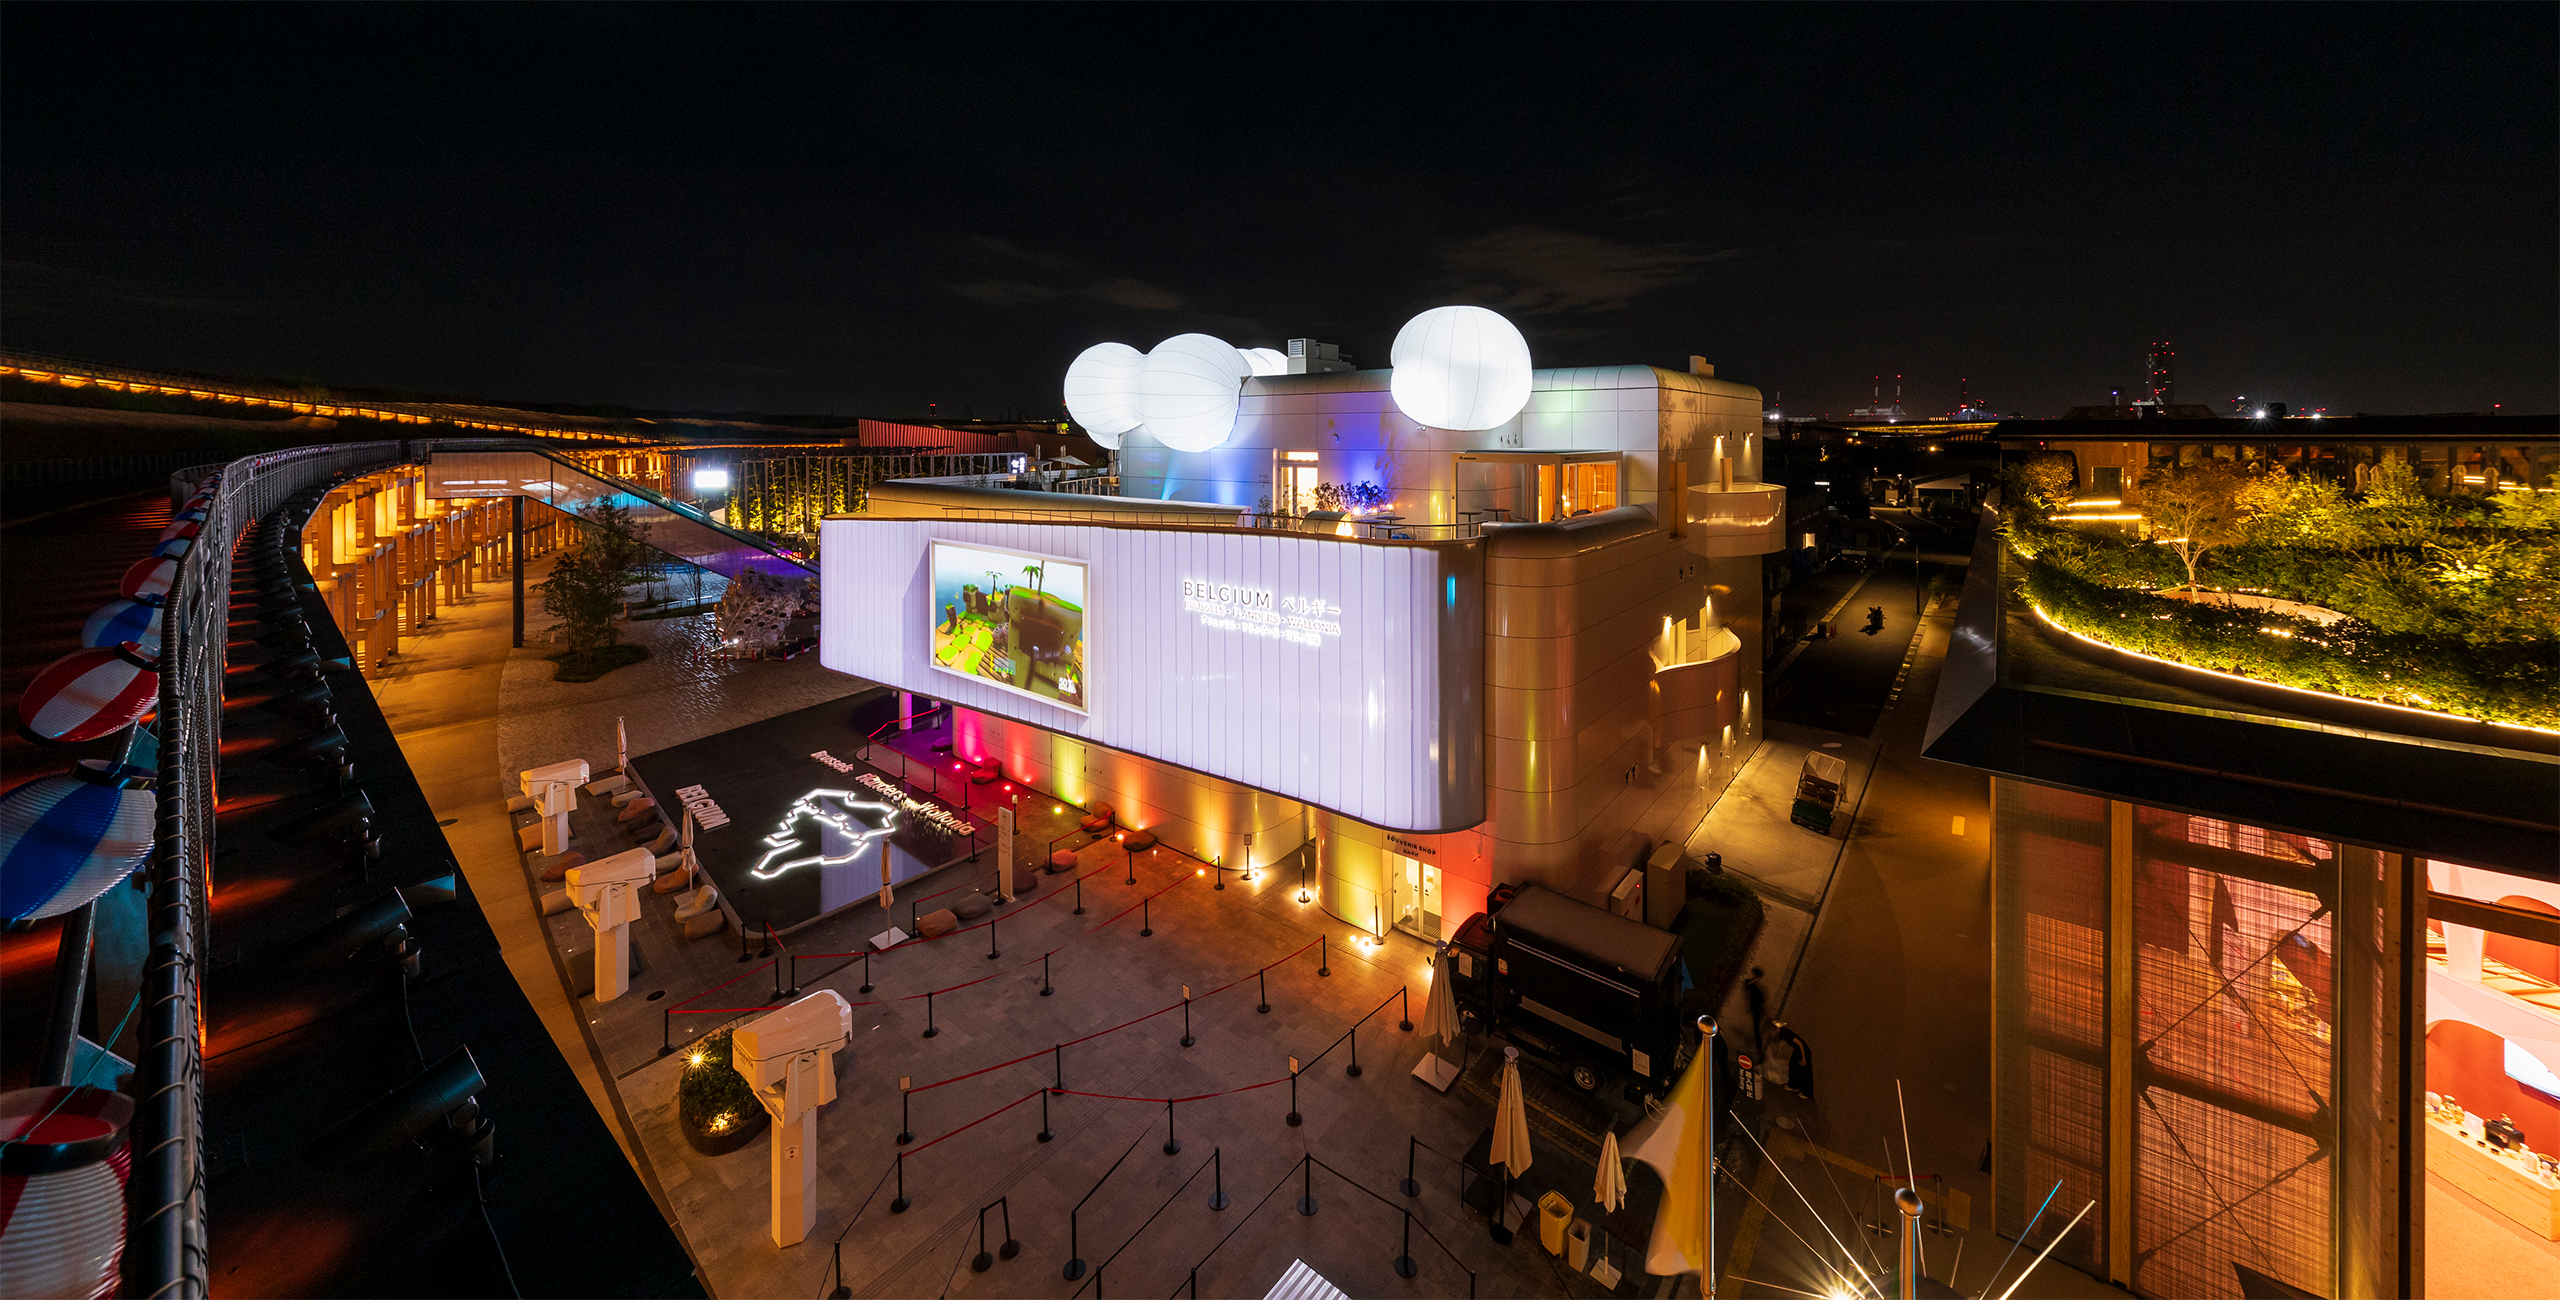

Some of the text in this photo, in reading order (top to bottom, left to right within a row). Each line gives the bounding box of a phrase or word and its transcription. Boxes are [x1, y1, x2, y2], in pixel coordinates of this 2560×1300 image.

[1184, 581, 1341, 616] BELGIUM ベルギー
[1184, 600, 1341, 635] BRUSSELS FLANDERS WALLONIA
[919, 801, 976, 836] Wallonia
[1387, 834, 1436, 855] SOUVENIR SHOP
